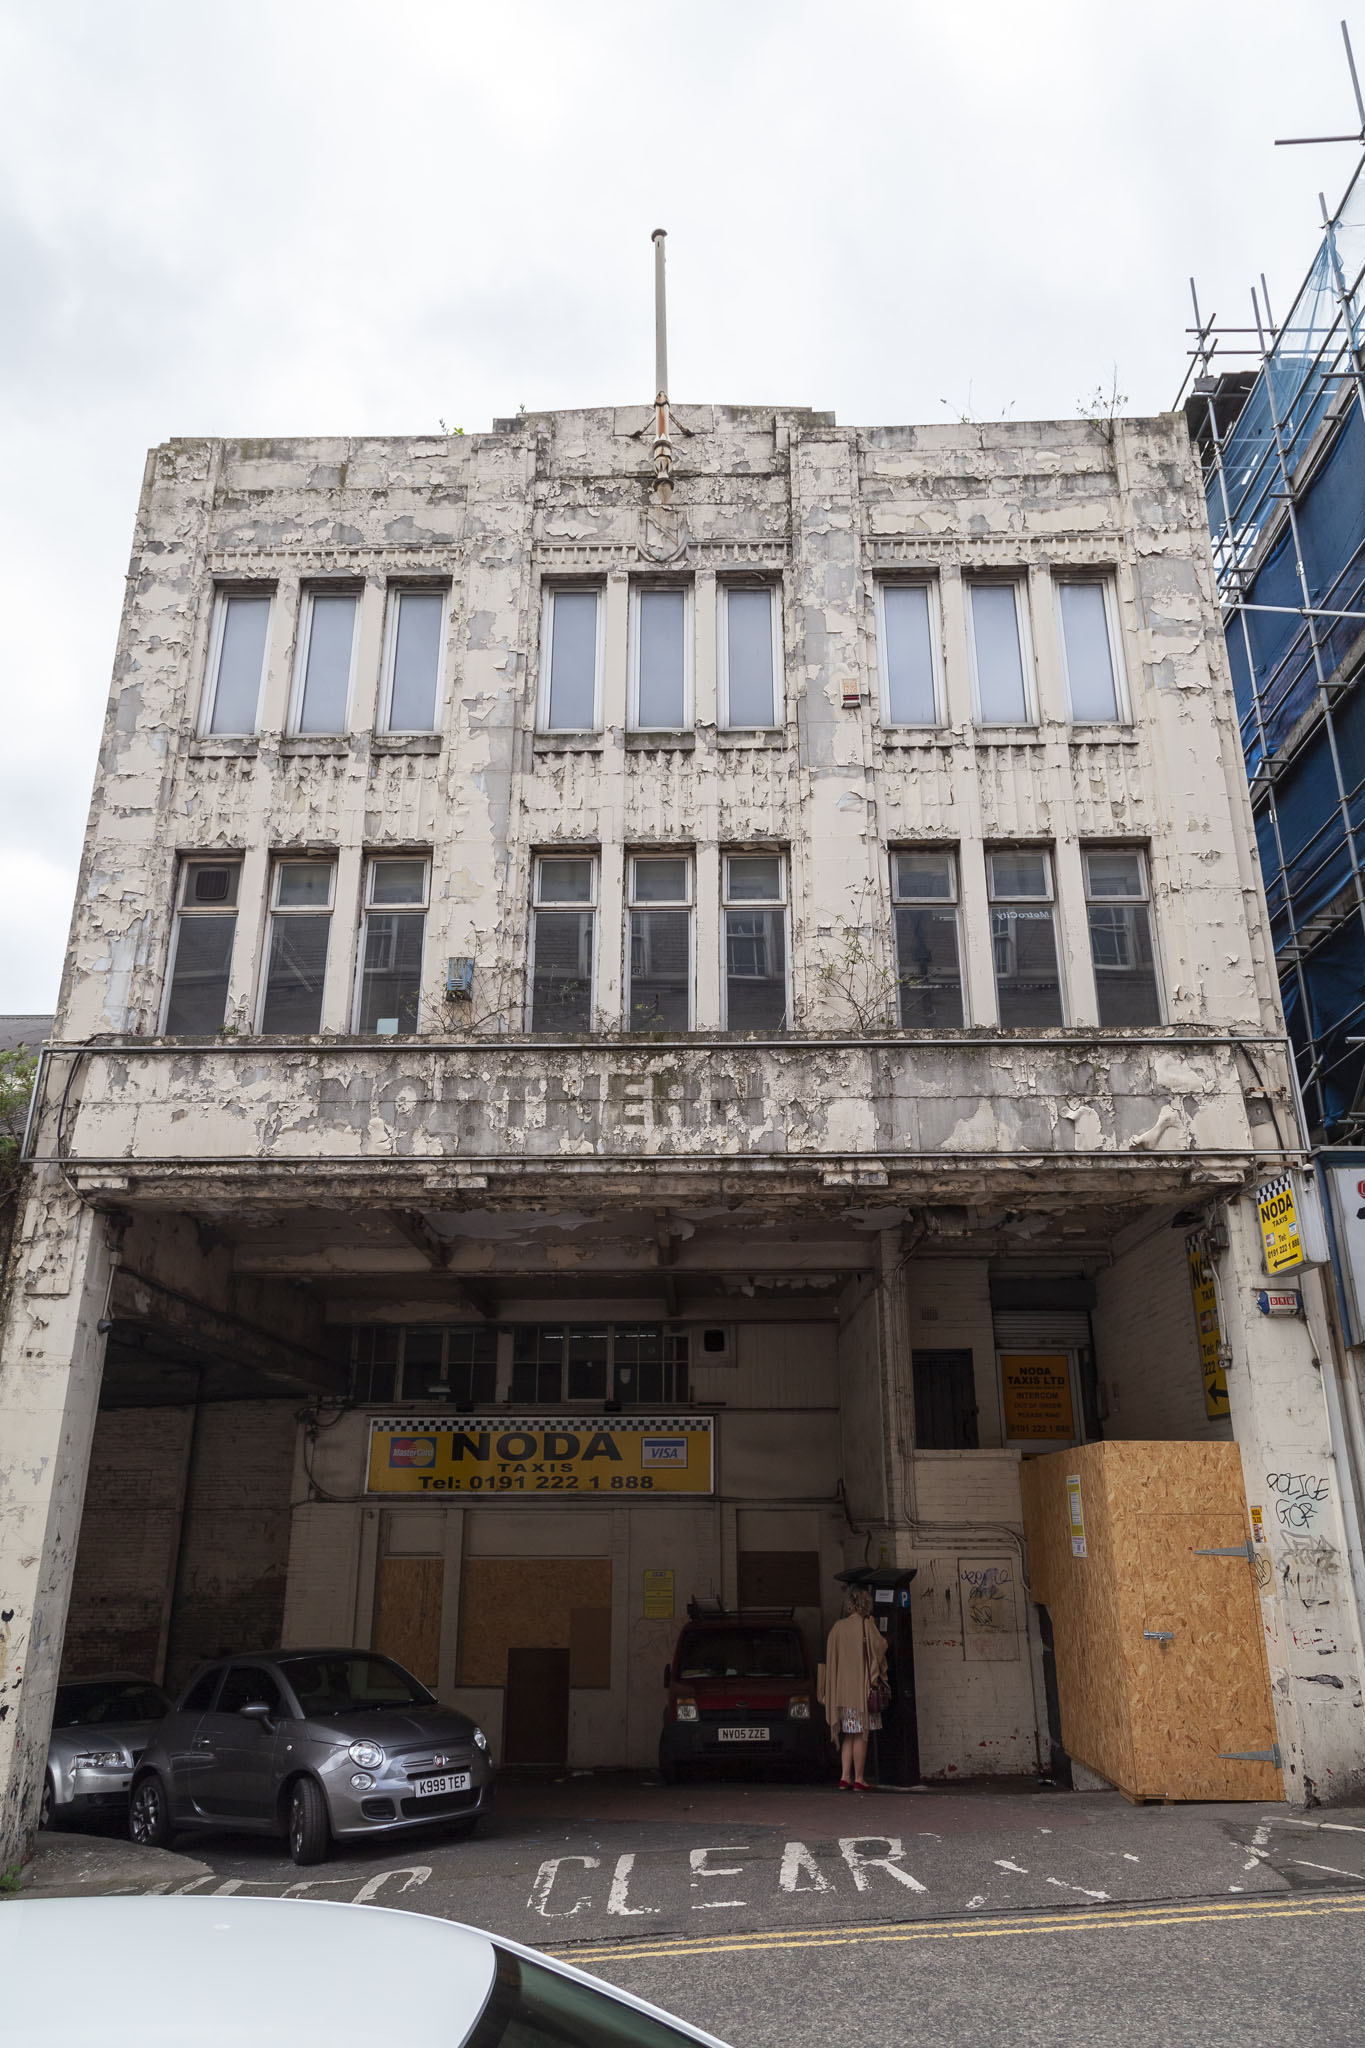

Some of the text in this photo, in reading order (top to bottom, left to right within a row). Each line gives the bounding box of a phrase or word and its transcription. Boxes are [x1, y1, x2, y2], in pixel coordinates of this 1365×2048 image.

[1261, 1194, 1293, 1223] NODA
[1272, 1215, 1288, 1228] TAXIS
[1278, 1233, 1287, 1243] Tel:
[1267, 1247, 1279, 1259] 0191
[1279, 1244, 1288, 1254] 222
[1291, 1238, 1300, 1248] 888
[1019, 1367, 1051, 1375] NODA
[1007, 1376, 1065, 1384] TAXIS LTD
[1031, 1424, 1046, 1432] 222
[392, 1447, 434, 1457] MasterCard
[452, 1432, 623, 1461] NODA
[651, 1447, 678, 1459] VISA
[498, 1463, 573, 1473] TAXIS
[418, 1476, 654, 1489] Tel: 0191 222 1 888
[722, 1729, 766, 1739] NV05 ZZE
[419, 1775, 466, 1795] K999 TEP
[527, 1836, 930, 1918] CLEAR
